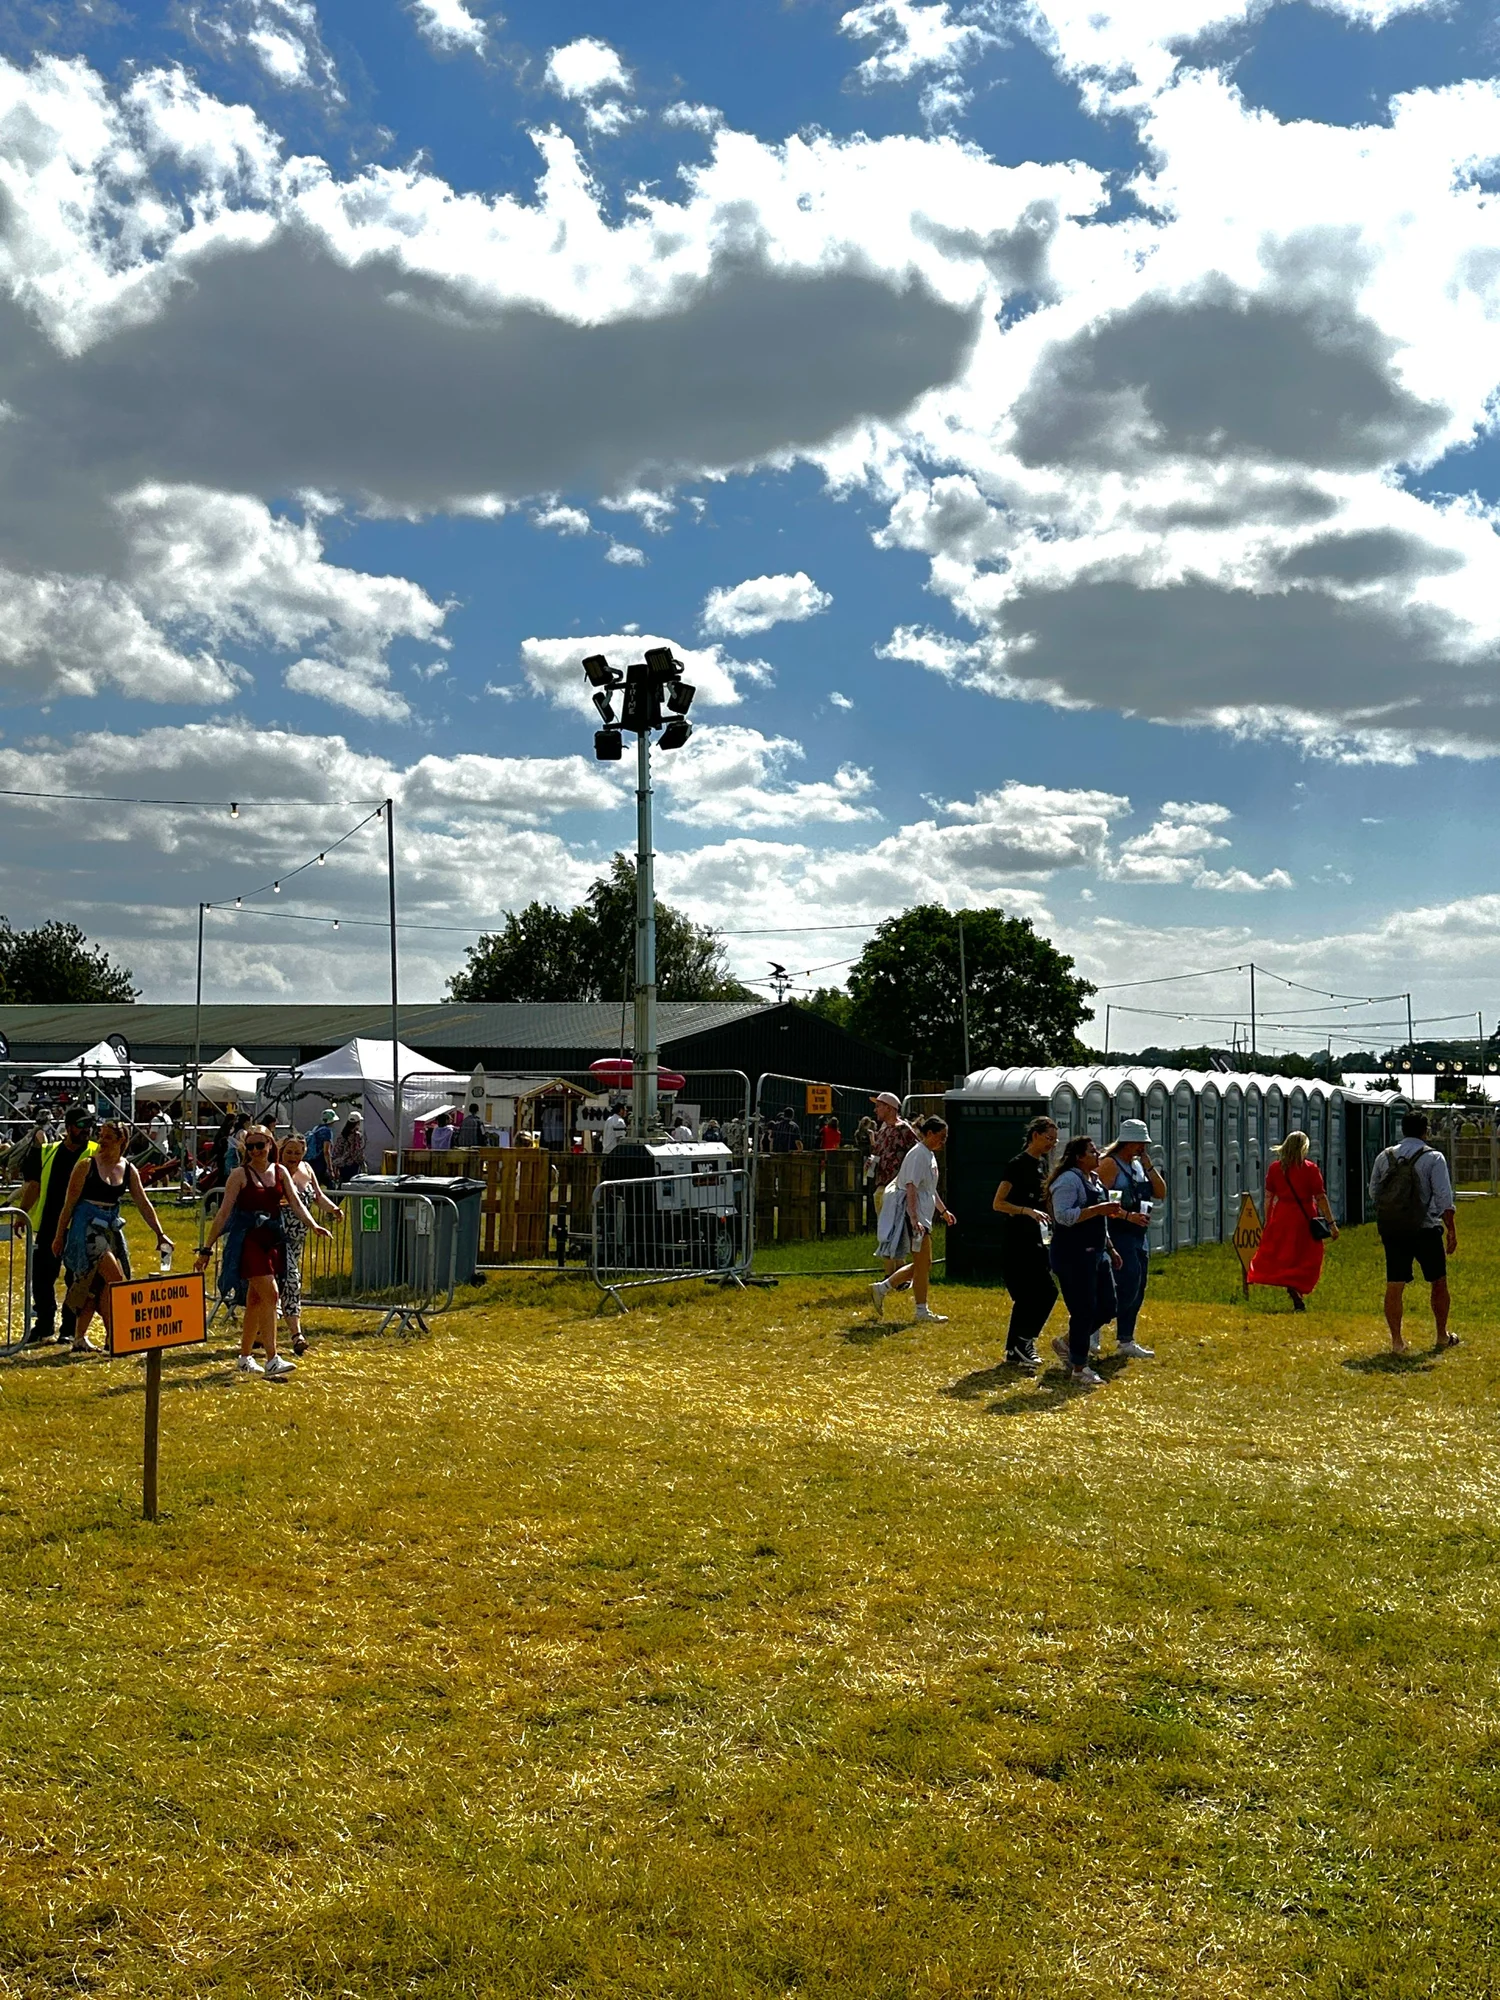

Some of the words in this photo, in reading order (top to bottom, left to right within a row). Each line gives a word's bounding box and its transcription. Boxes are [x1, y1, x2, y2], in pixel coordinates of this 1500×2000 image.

[1237, 1226, 1262, 1249] LOOS
[131, 1290, 144, 1306] NO
[150, 1285, 190, 1303] ALCOHOL
[135, 1304, 173, 1323] BEYOND
[129, 1325, 152, 1342] THIS
[156, 1319, 183, 1337] POINT
